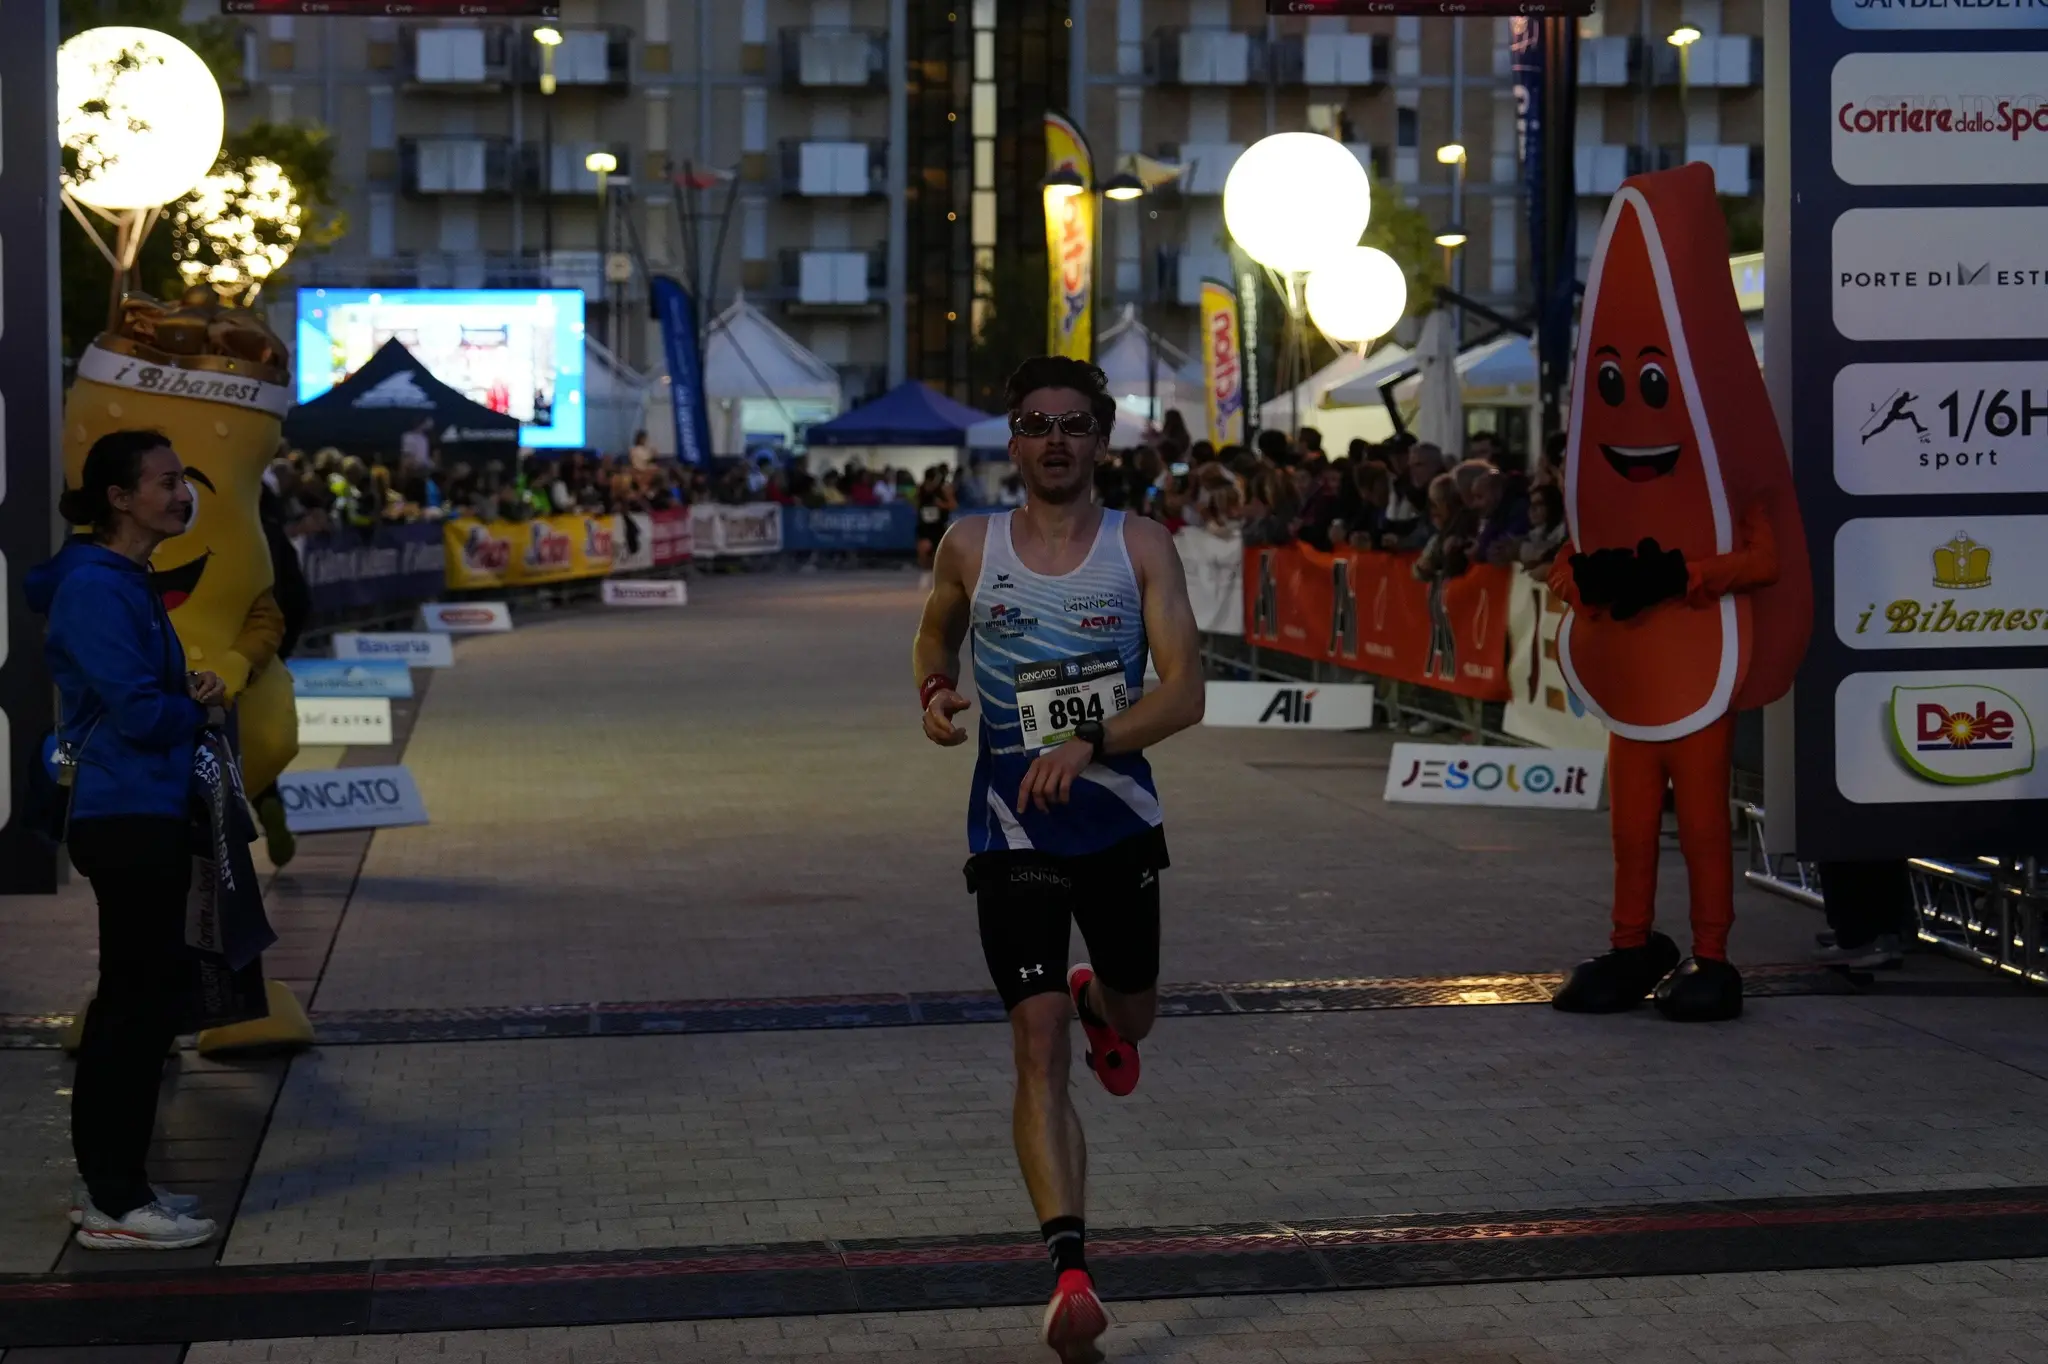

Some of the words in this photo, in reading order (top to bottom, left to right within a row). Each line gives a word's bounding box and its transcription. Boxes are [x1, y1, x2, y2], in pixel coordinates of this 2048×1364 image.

[1838, 102, 1952, 133] Corriere
[1955, 111, 1995, 133] dello
[1841, 272, 1917, 287] PORTE
[1928, 272, 1951, 286] DI
[114, 361, 135, 381] i
[136, 365, 264, 402] Bibanesi
[1919, 450, 1998, 470] sport
[1855, 603, 1876, 634] i
[1018, 668, 1057, 682] LONGATO
[1081, 659, 1120, 674] MOONLIGHT
[1055, 685, 1081, 697] DANIEL
[1048, 692, 1105, 730] 894
[1916, 701, 2015, 746] Dole
[1401, 759, 1588, 795] JESOLO.it
[279, 777, 400, 811] ONGATO
